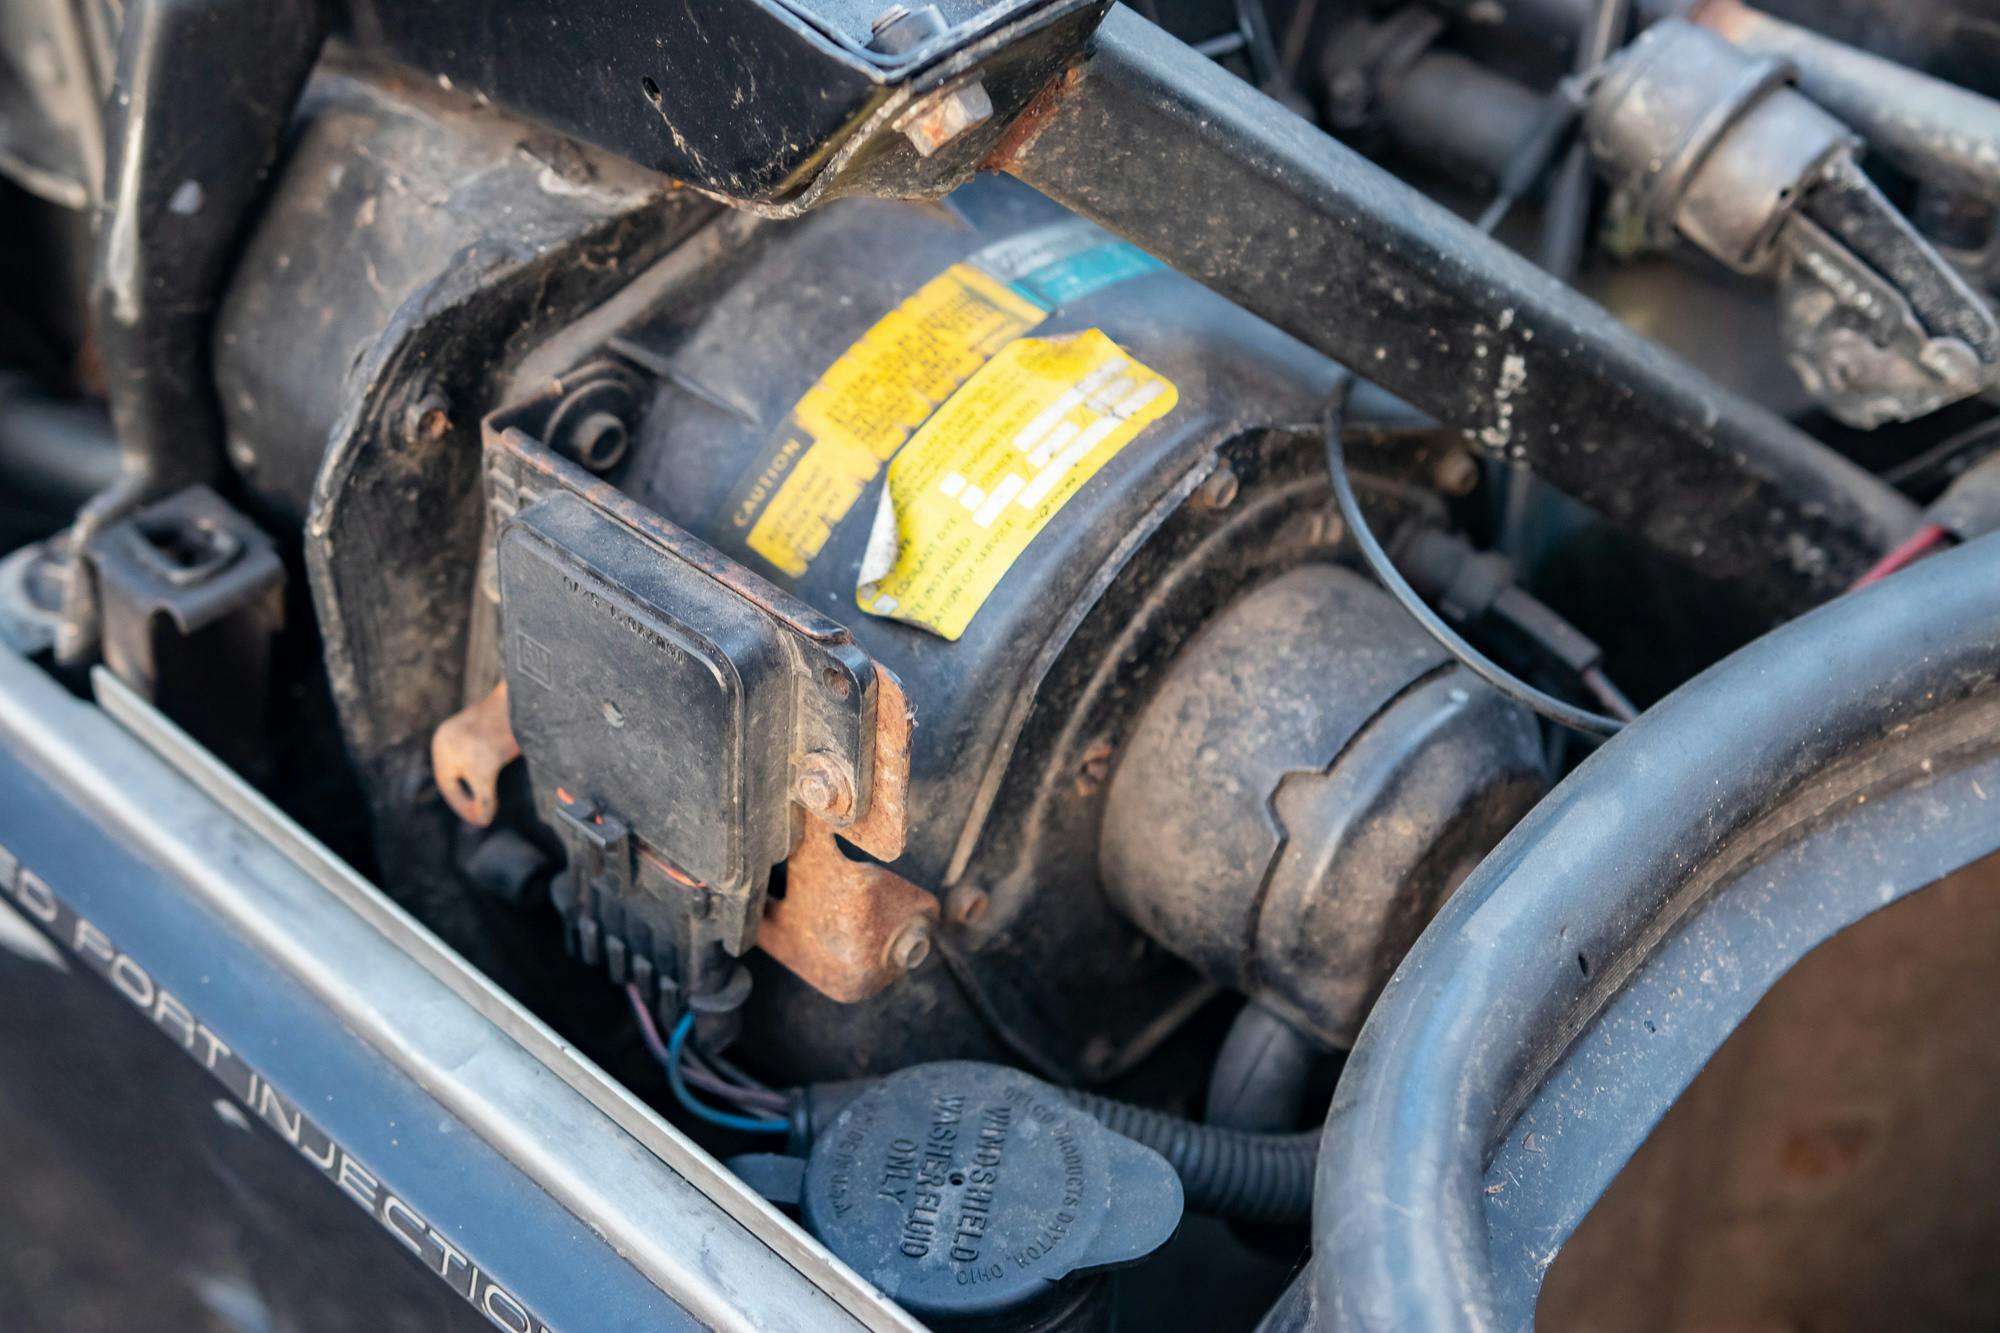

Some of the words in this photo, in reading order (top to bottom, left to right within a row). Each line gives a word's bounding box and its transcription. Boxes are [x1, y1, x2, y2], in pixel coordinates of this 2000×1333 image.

[733, 437, 801, 528] CAUTION
[894, 542, 937, 597] COOLANT
[936, 517, 958, 541] DYE
[965, 566, 976, 584] OF
[976, 519, 1013, 563] SERVICE
[74, 915, 232, 1068] PORT
[878, 1137, 919, 1204] ONLY
[916, 1094, 965, 1189] WASHER
[1054, 1122, 1085, 1206] PRODUCTS
[900, 1185, 943, 1260] FLUID
[950, 1106, 1011, 1263] WINDSHIELD
[955, 1264, 1005, 1286] OHIO
